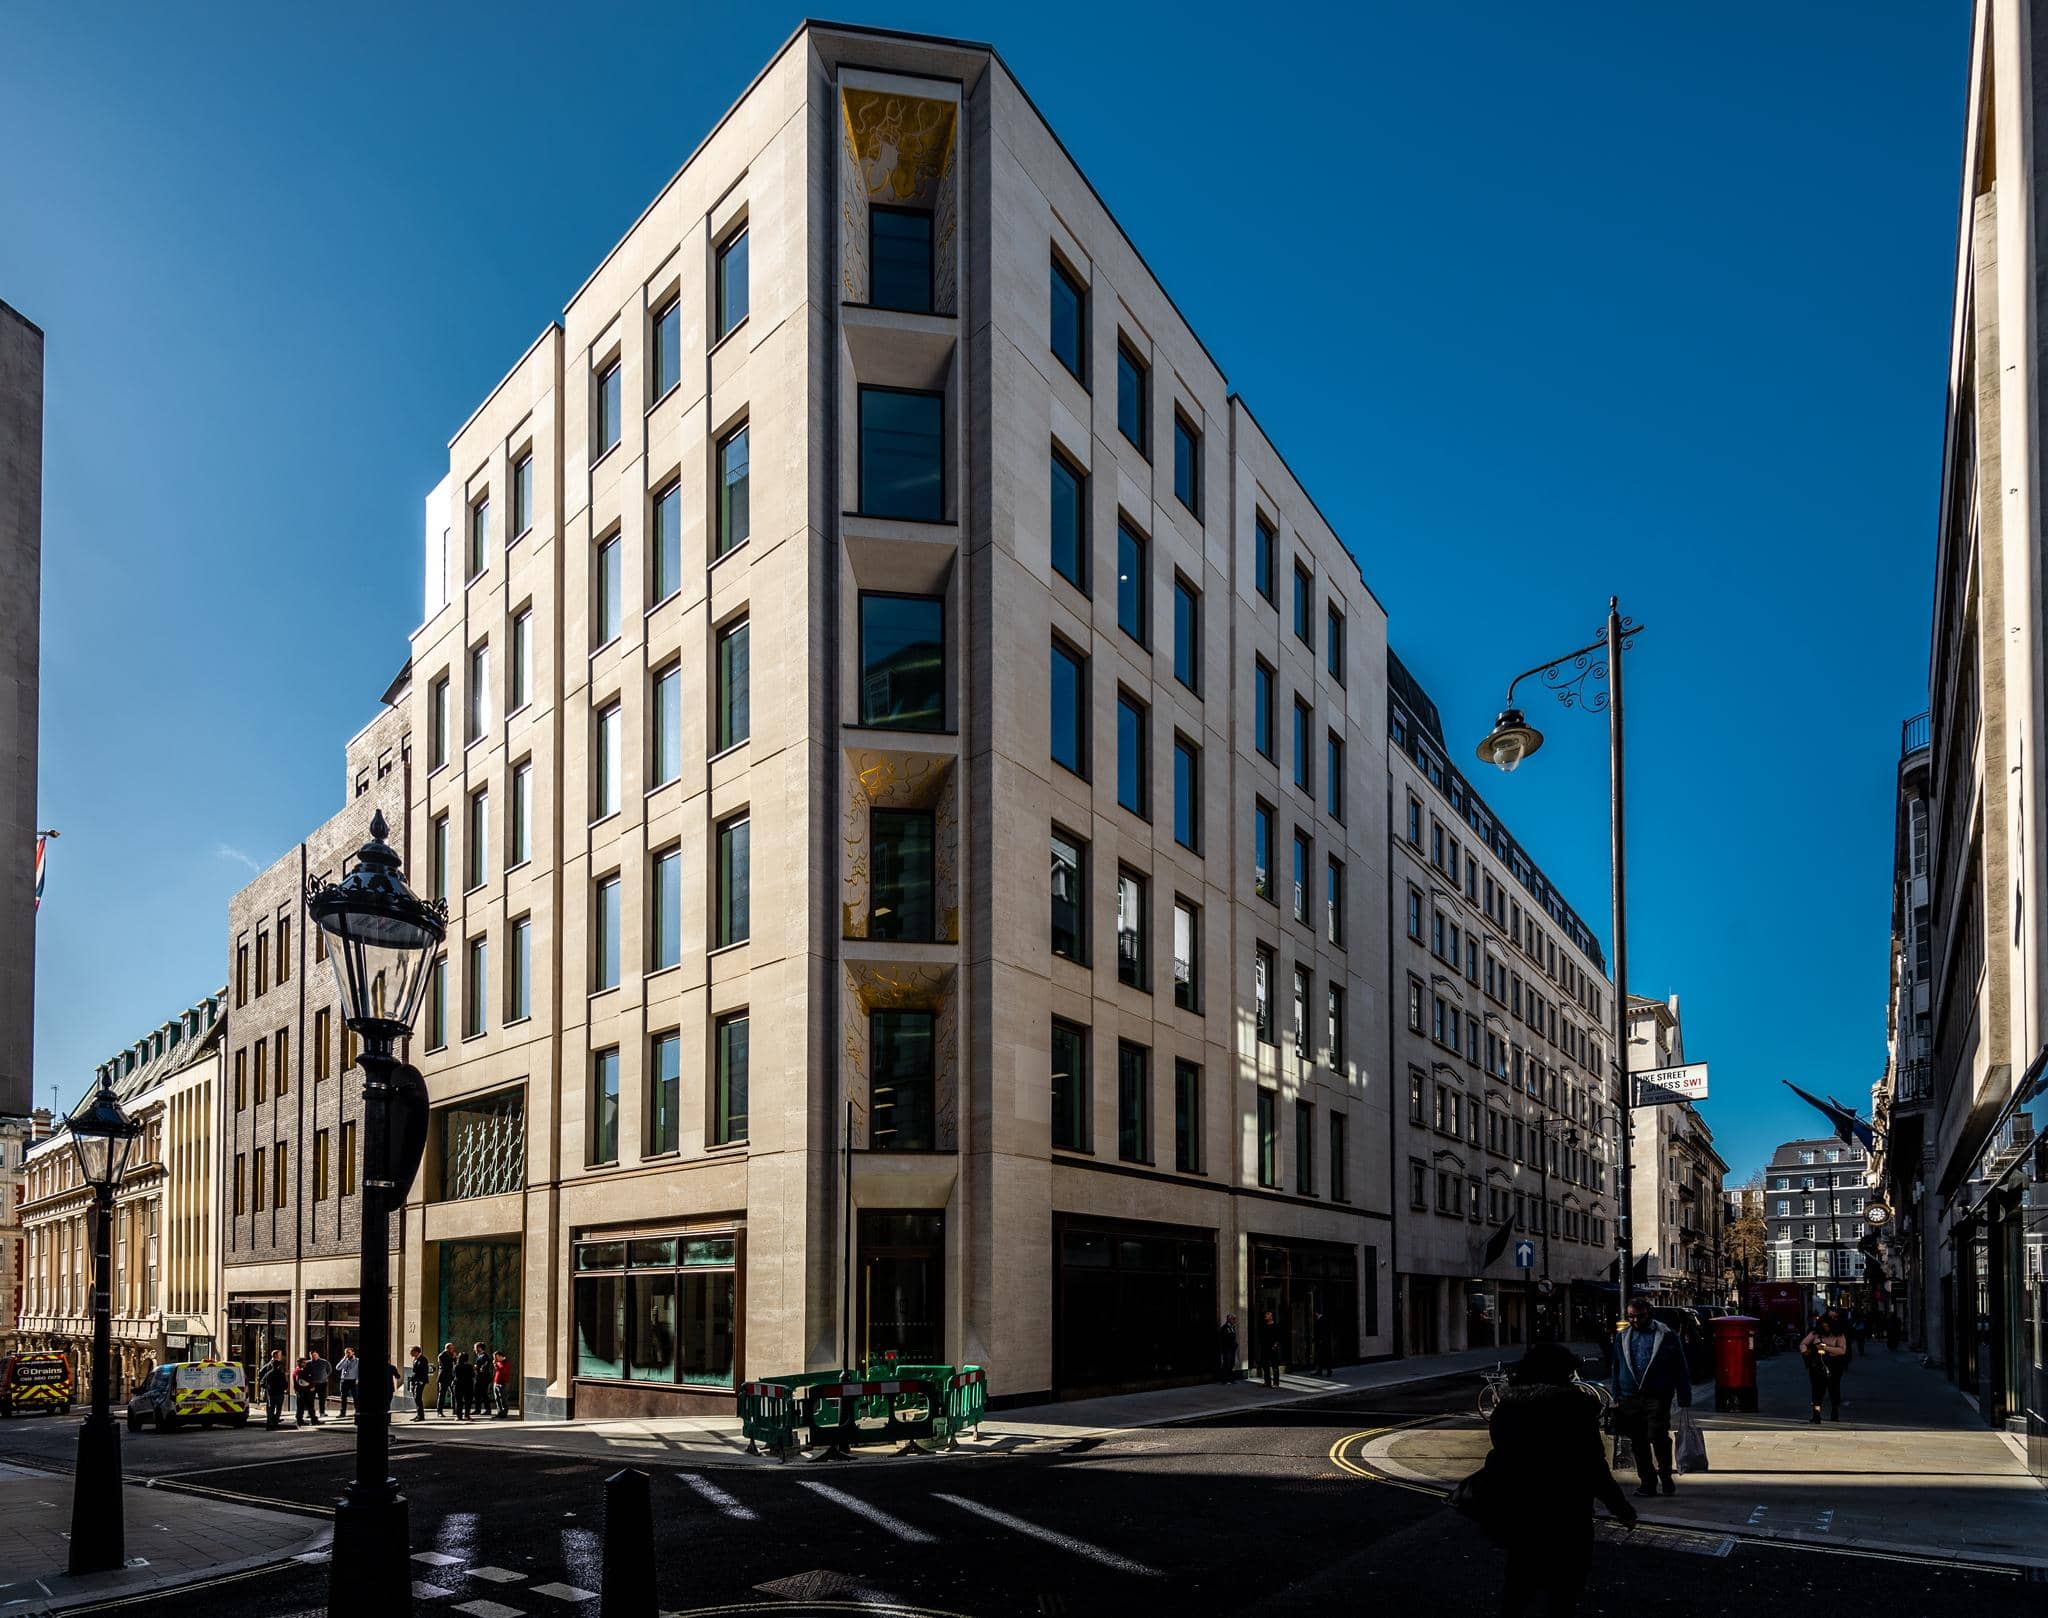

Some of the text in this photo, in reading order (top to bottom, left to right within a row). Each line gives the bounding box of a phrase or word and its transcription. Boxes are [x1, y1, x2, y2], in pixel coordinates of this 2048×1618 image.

[1657, 1070, 1687, 1081] STREET
[1683, 1078, 1702, 1088] SW1
[30, 1367, 62, 1375] Drains
